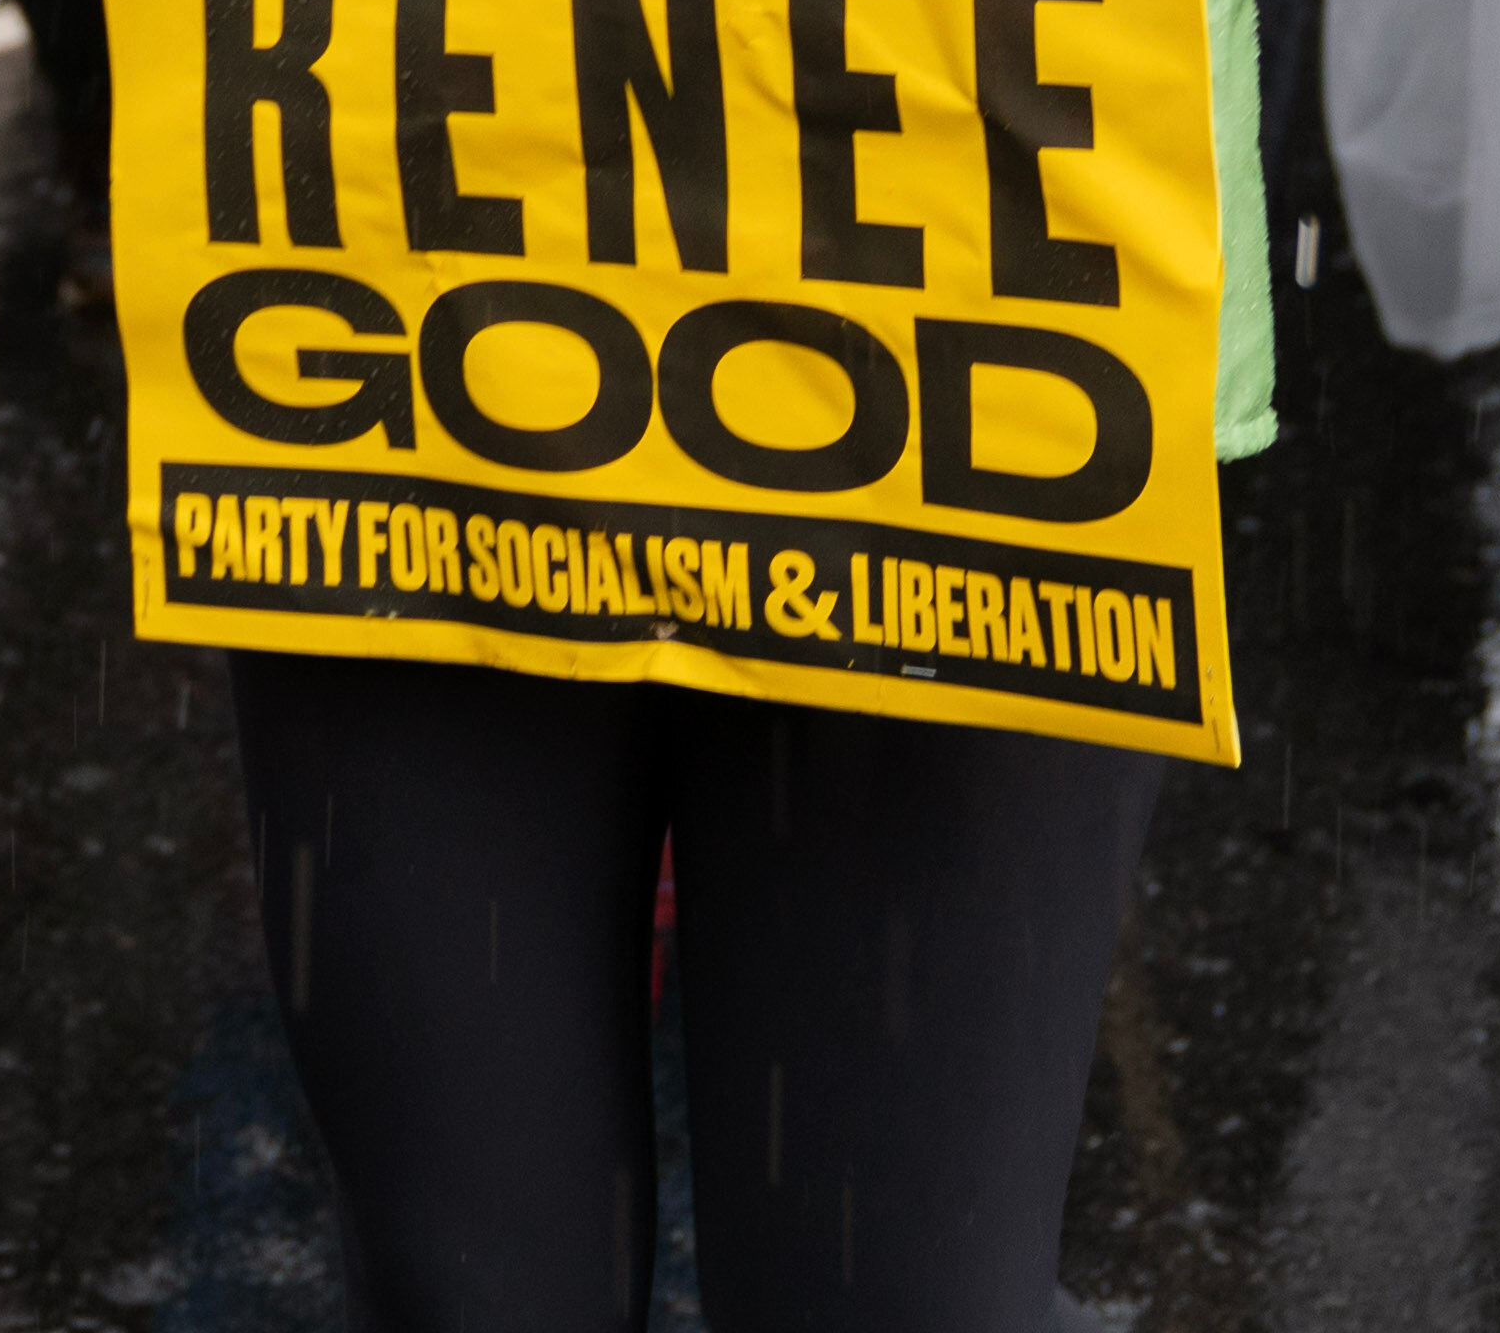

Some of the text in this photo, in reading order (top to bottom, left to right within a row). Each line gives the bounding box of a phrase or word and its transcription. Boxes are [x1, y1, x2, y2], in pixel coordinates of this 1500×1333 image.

[182, 267, 1154, 523] GOOD
[176, 492, 1176, 690] PARTY FOR SOCIALISM & LIBERATION
